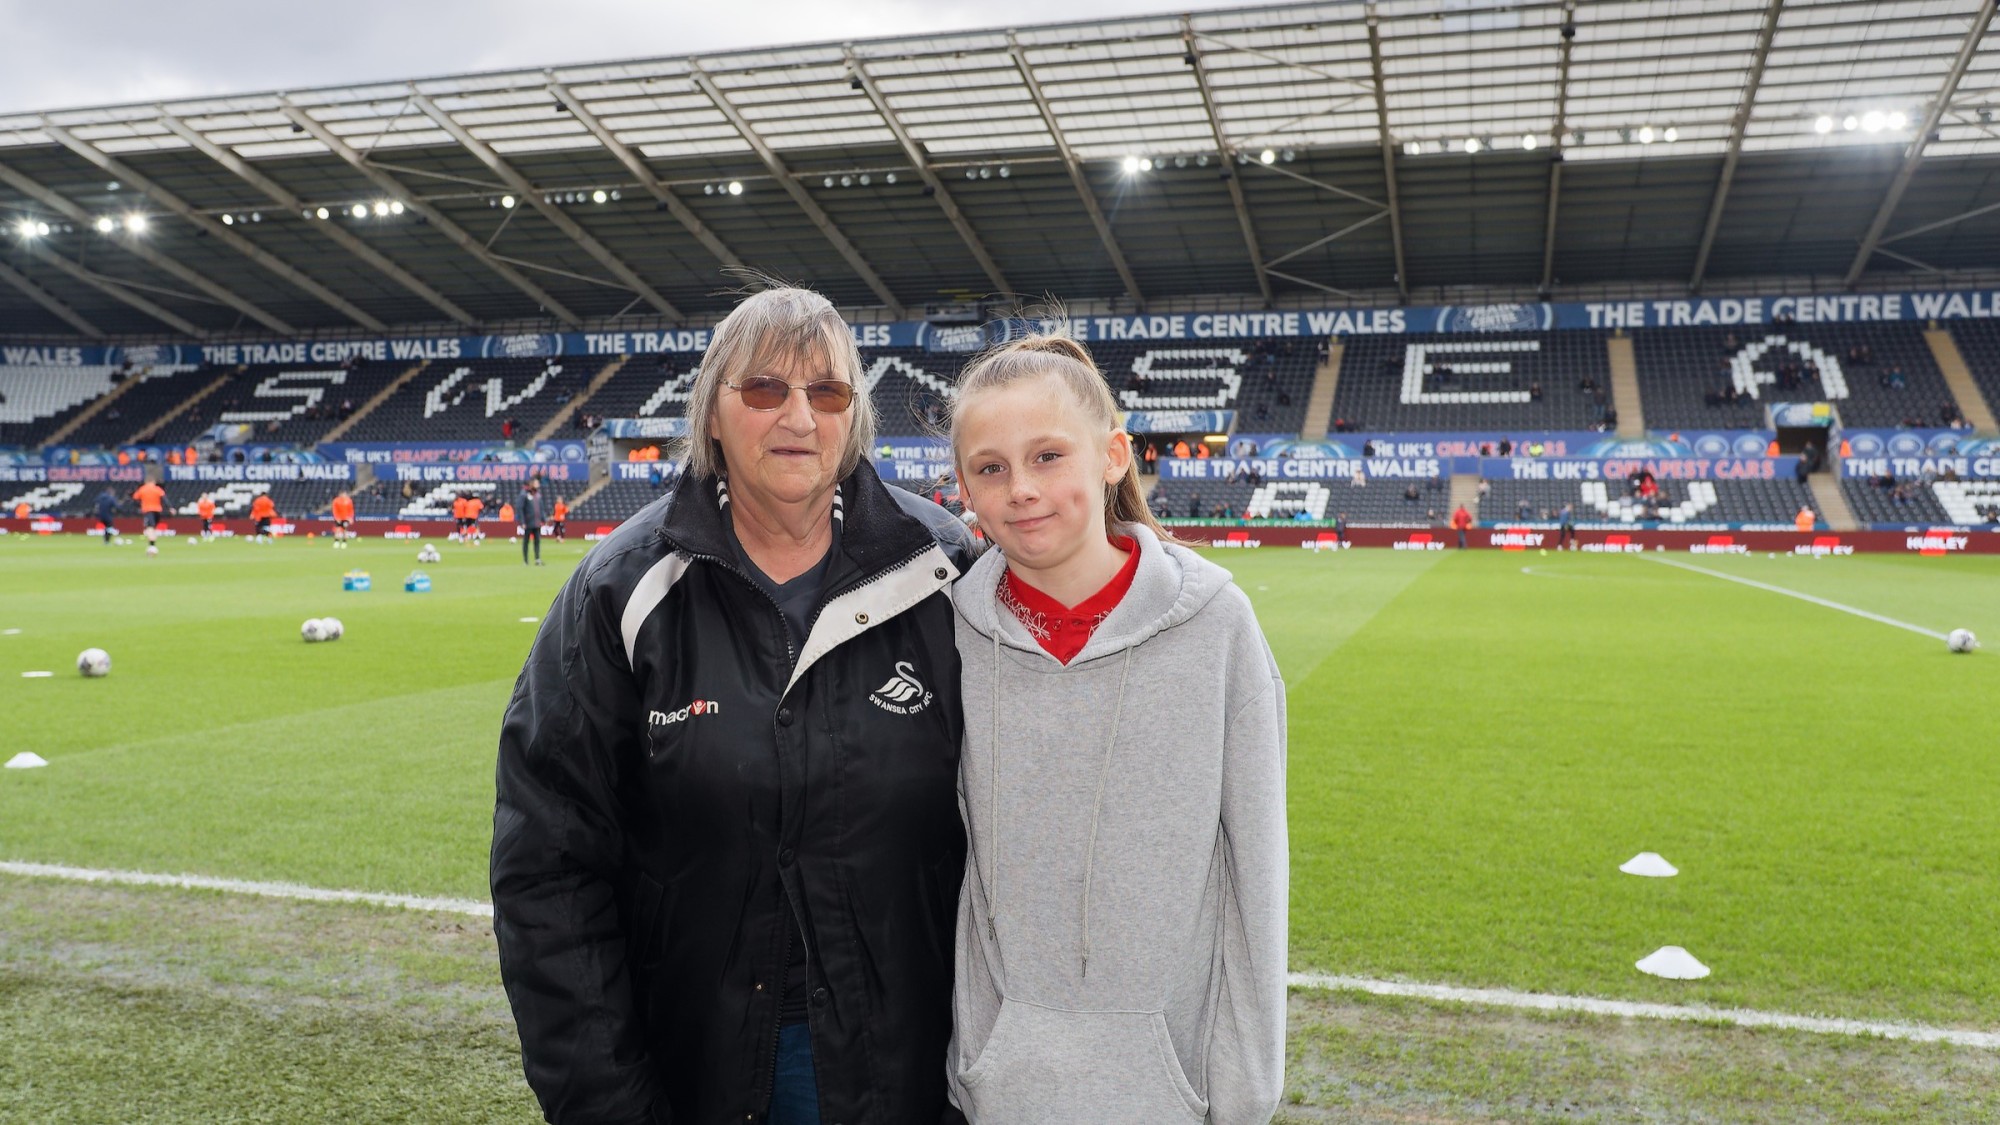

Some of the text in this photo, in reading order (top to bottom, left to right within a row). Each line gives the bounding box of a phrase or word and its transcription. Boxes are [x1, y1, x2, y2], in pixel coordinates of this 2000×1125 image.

[1586, 302, 1644, 327] THE
[1653, 299, 1763, 326] TRADE
[1772, 295, 1902, 322] CENTRE
[1094, 315, 1186, 339] TRADE
[1193, 312, 1300, 338] CENTRE
[1307, 309, 1406, 335] WALES
[585, 331, 708, 354] THE TRADE
[850, 324, 891, 346] LES
[3, 346, 83, 366] WALES
[202, 339, 461, 365] THE TRADE CENTRE WALES
[874, 446, 922, 459] CNTRE
[1398, 442, 1434, 457] UK'S
[1436, 441, 1518, 457] CHEAPET
[1520, 441, 1567, 457] CRS
[170, 464, 350, 480] THE TRADE CENTRE WALES
[396, 466, 421, 481] THE
[424, 466, 455, 481] UK'S
[456, 464, 527, 481] CHEAPEST
[619, 463, 650, 479] THE
[895, 464, 926, 479] THE
[1169, 459, 1440, 478] THE TRADE CENTRE WALES
[1511, 459, 1775, 480] THE UK'S CHEAPEST CARS
[1845, 458, 1888, 477] THE
[1892, 458, 1968, 477] TRADE
[1490, 533, 1544, 546] HURLEY
[1906, 536, 1969, 550] HURLEY
[868, 691, 934, 716] SWANSEA CITY AFC
